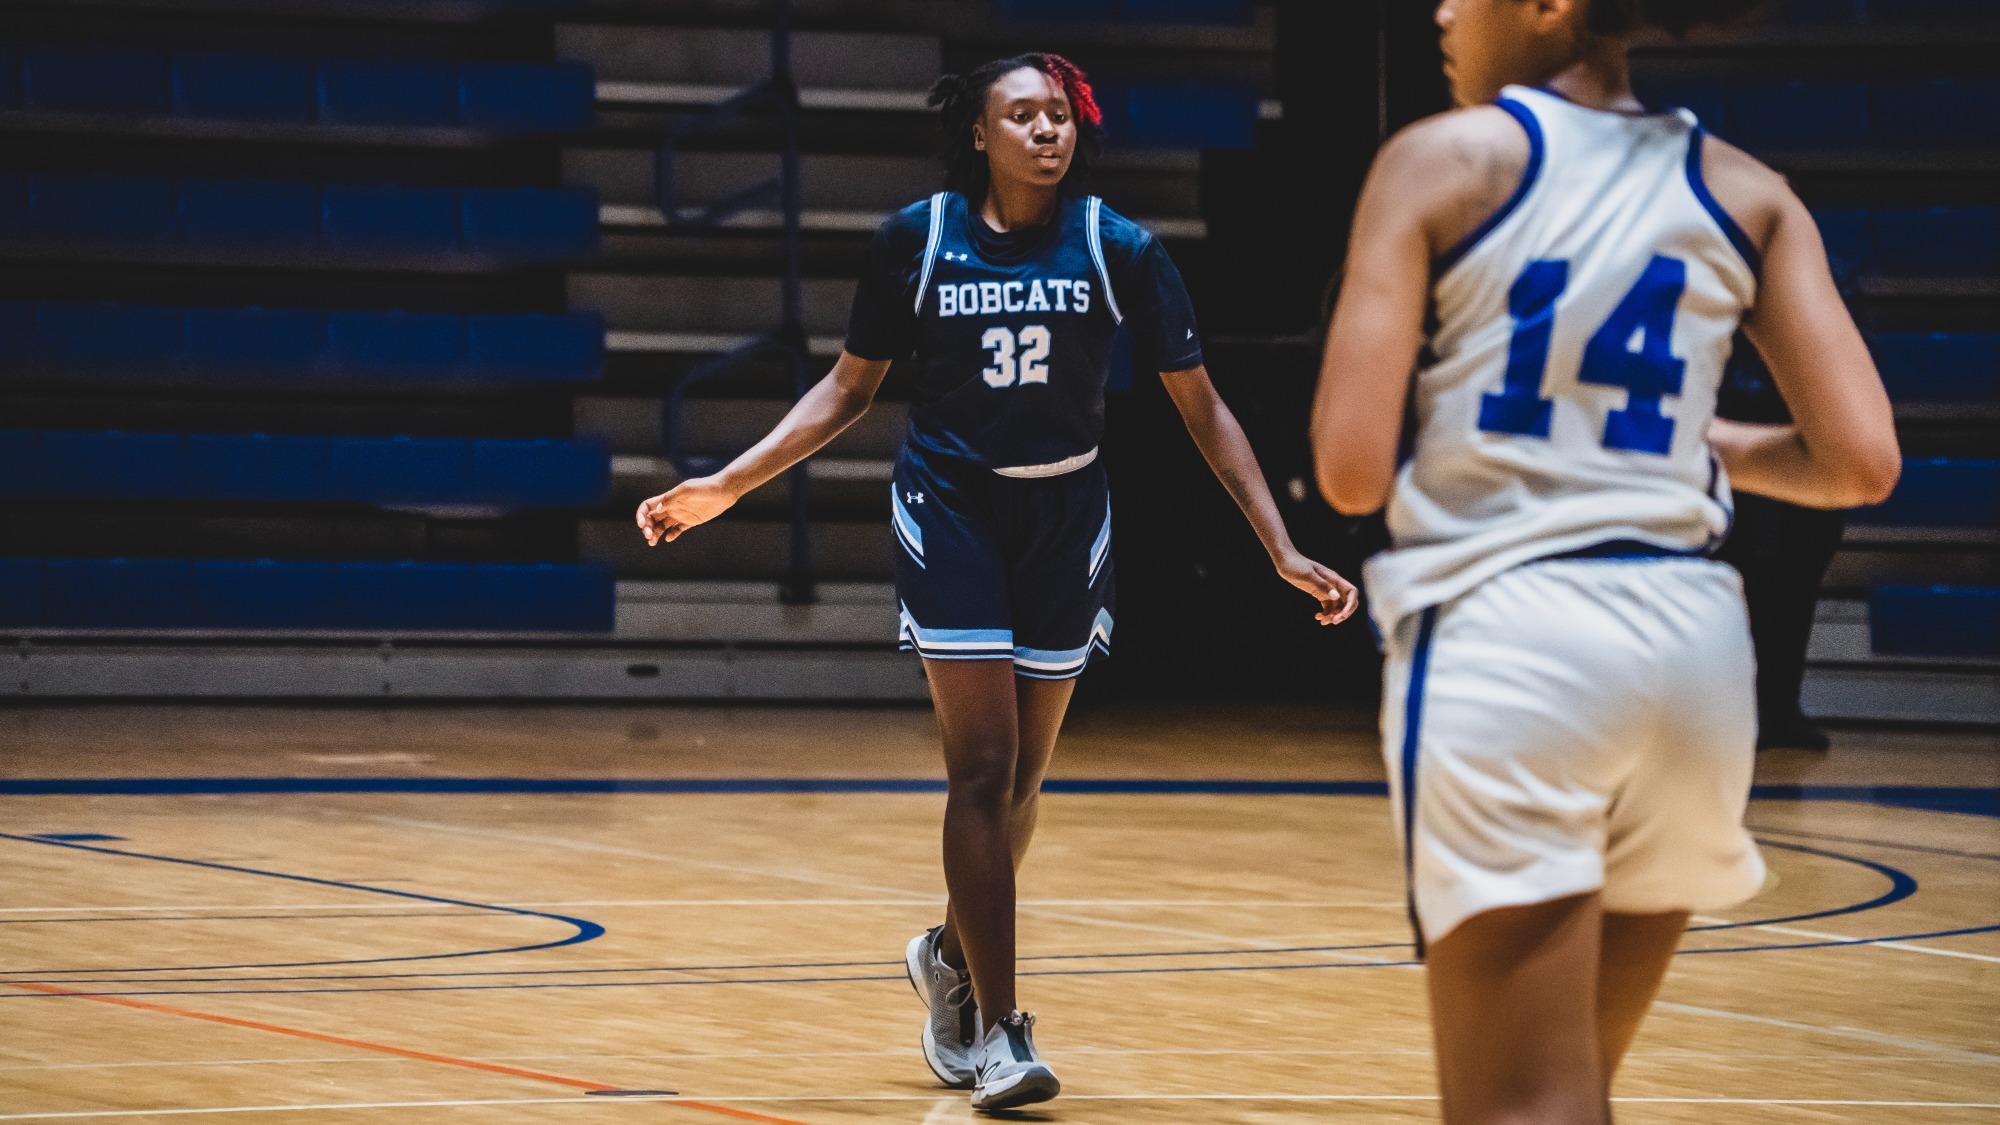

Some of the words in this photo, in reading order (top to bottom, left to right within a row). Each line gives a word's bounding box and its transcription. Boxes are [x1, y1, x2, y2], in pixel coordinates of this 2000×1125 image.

[938, 279, 1090, 317] BOBCATS
[981, 325, 1050, 388] 32
[1477, 254, 1686, 456] 14
